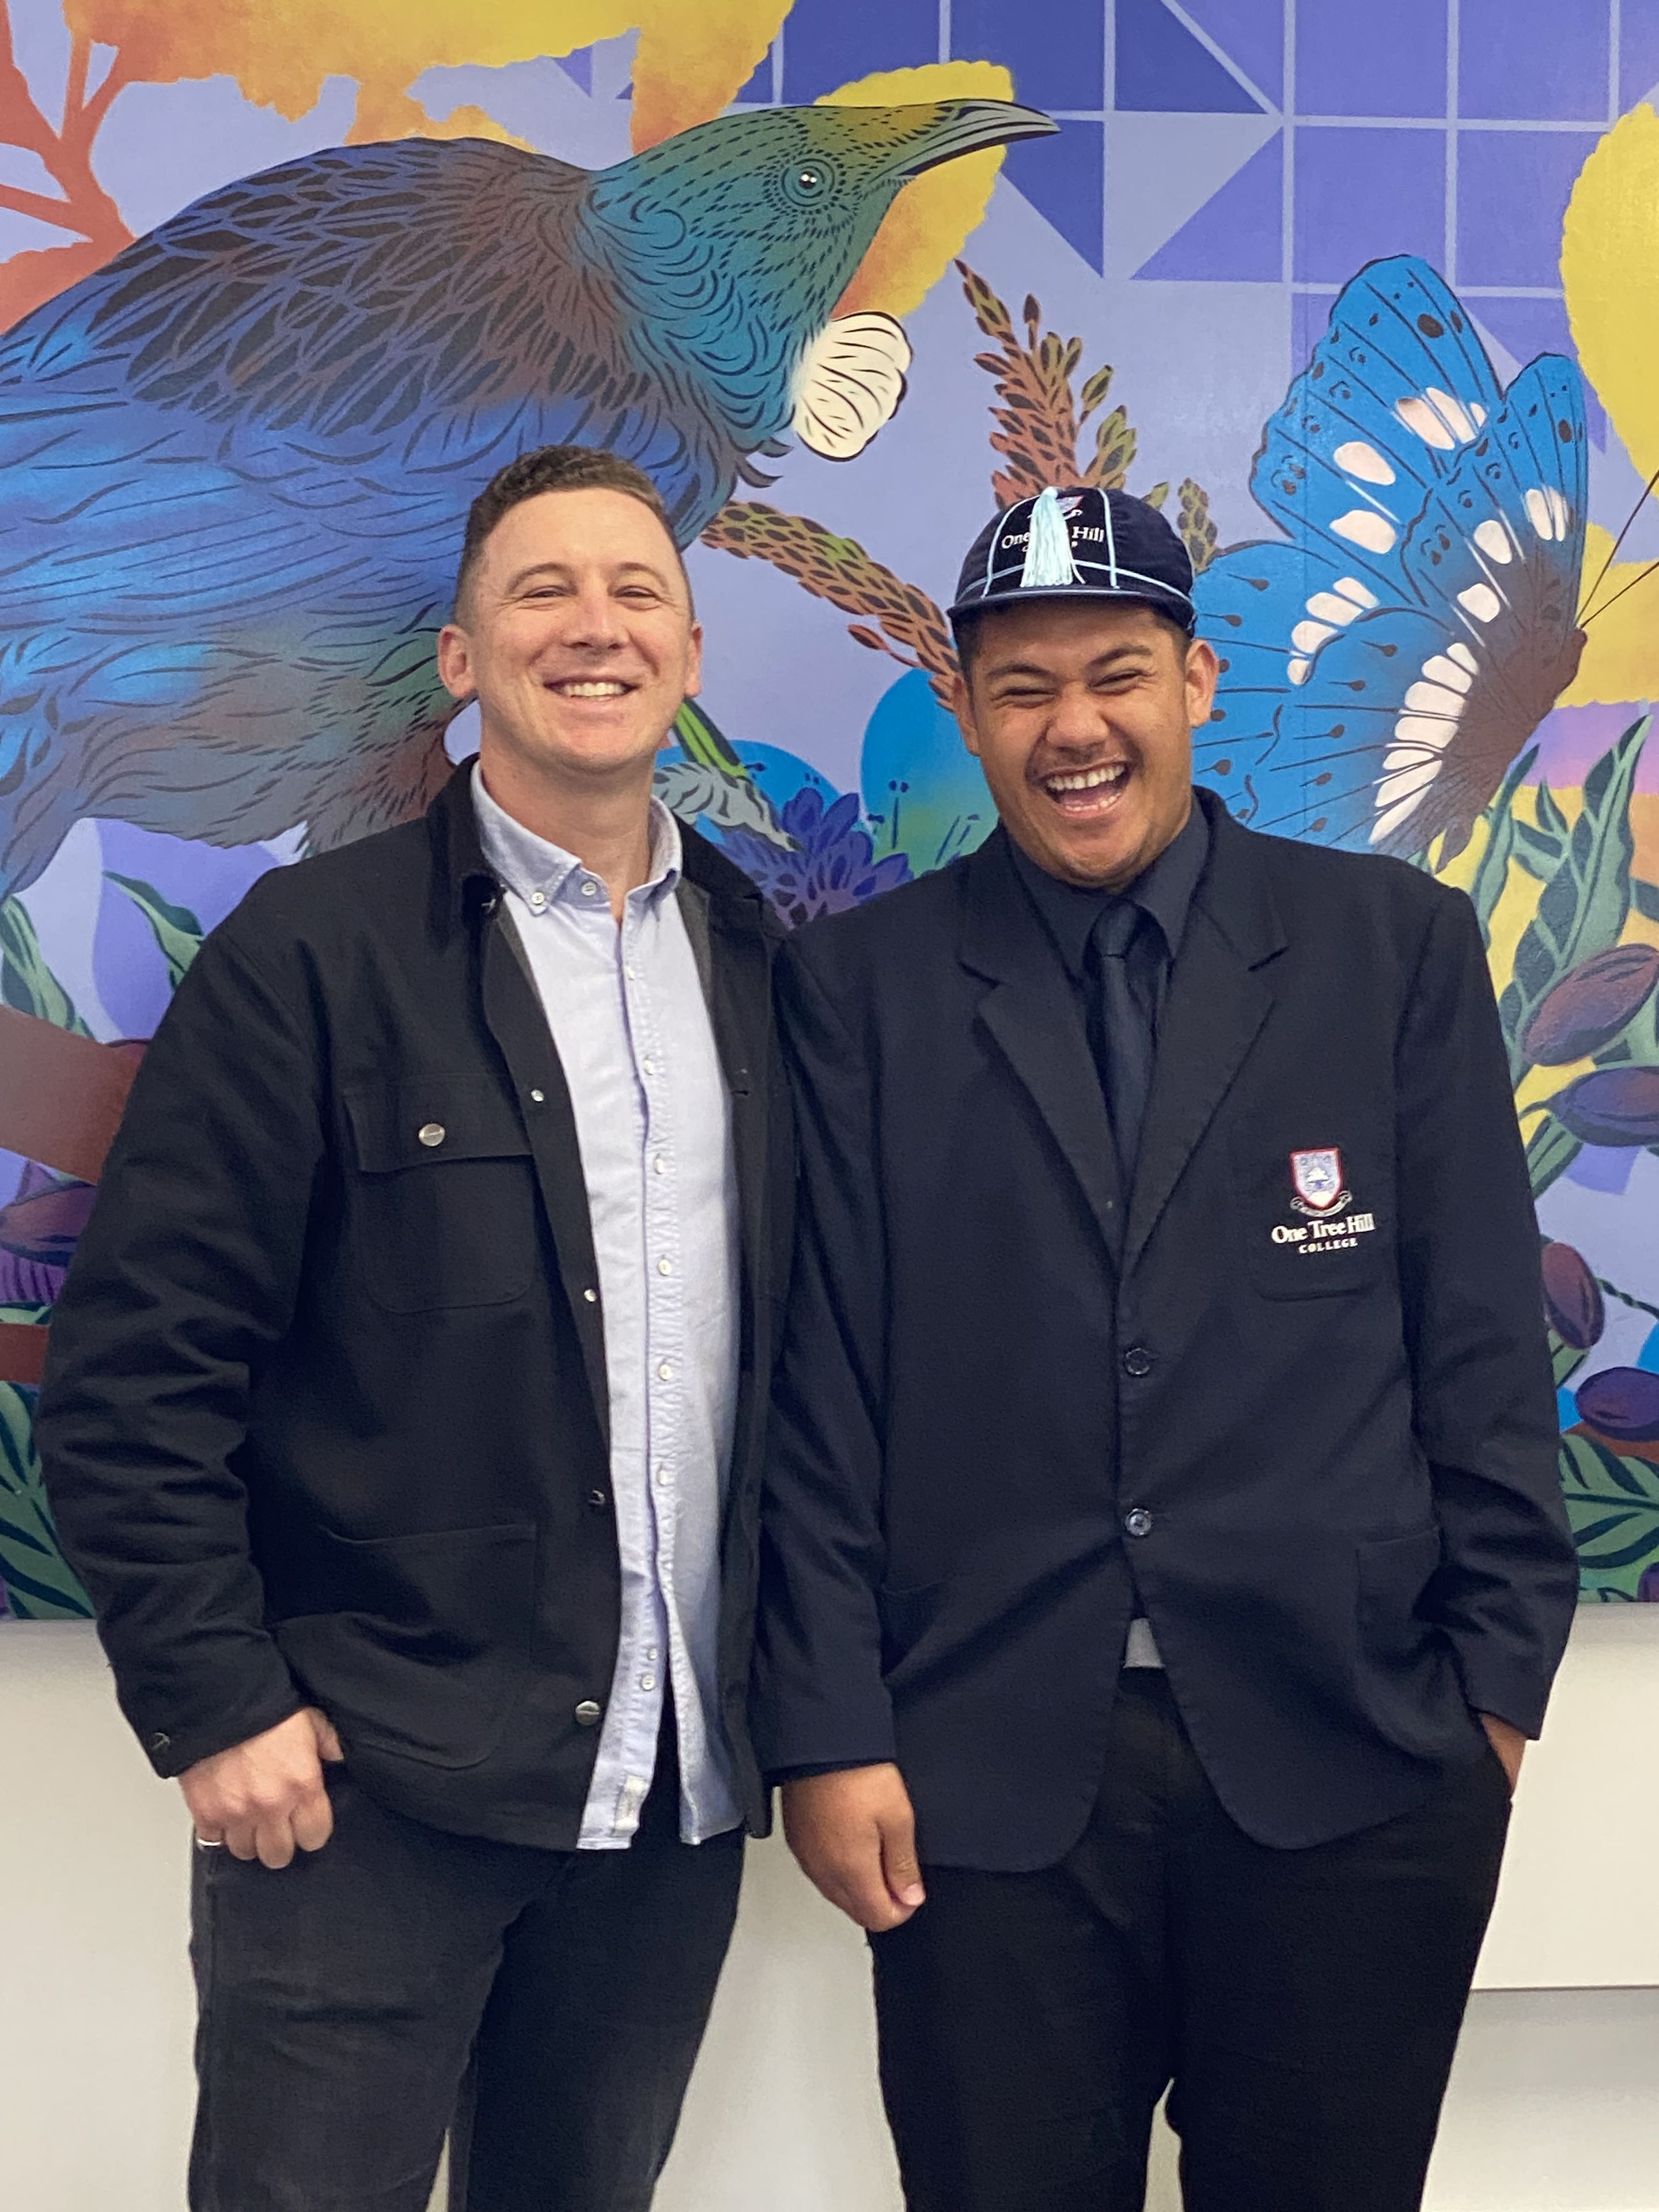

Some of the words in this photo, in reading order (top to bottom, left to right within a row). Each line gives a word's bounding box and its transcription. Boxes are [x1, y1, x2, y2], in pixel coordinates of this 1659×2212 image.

[1001, 532, 1030, 549] One
[1071, 526, 1104, 543] Hill
[1271, 1225, 1308, 1244] One
[1308, 1220, 1347, 1239] Tree
[1346, 1213, 1376, 1234] Hill
[1298, 1238, 1358, 1254] COLLEGE
